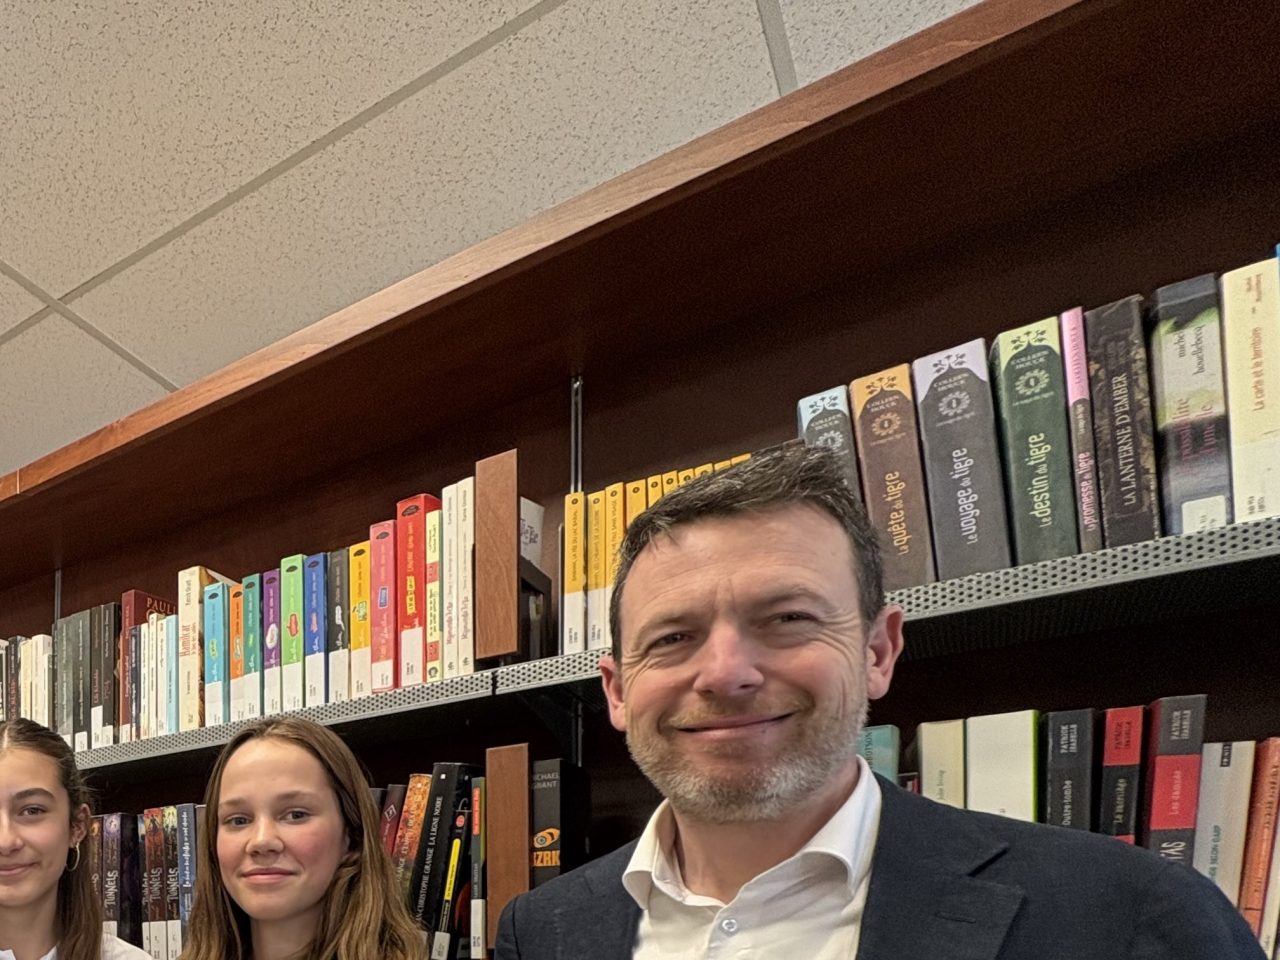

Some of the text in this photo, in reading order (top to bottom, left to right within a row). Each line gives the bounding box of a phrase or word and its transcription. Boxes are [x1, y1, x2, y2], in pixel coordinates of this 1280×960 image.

[1111, 372, 1132, 426] D'EMBER
[1074, 451, 1095, 474] tigre
[1115, 427, 1137, 490] LANTERNE
[949, 447, 981, 545] Le voyage du tigre
[1025, 432, 1053, 528] Le destin du tigre
[883, 470, 912, 556] La quête du tigre
[1078, 480, 1098, 525] promesse
[1122, 491, 1138, 506] LA
[1059, 724, 1069, 754] PATRICK
[1169, 710, 1181, 740] PATRICK
[533, 772, 560, 782] ICHAEL
[433, 796, 443, 816] NOIRE
[428, 837, 436, 846] LA
[429, 817, 440, 837] LIGNE
[533, 850, 560, 867] ZRK
[104, 870, 119, 908] TUNNELS
[149, 866, 163, 902] TUNNELS
[166, 866, 179, 902] TUNNELS
[415, 874, 430, 922] AN-CHRISTOPHE
